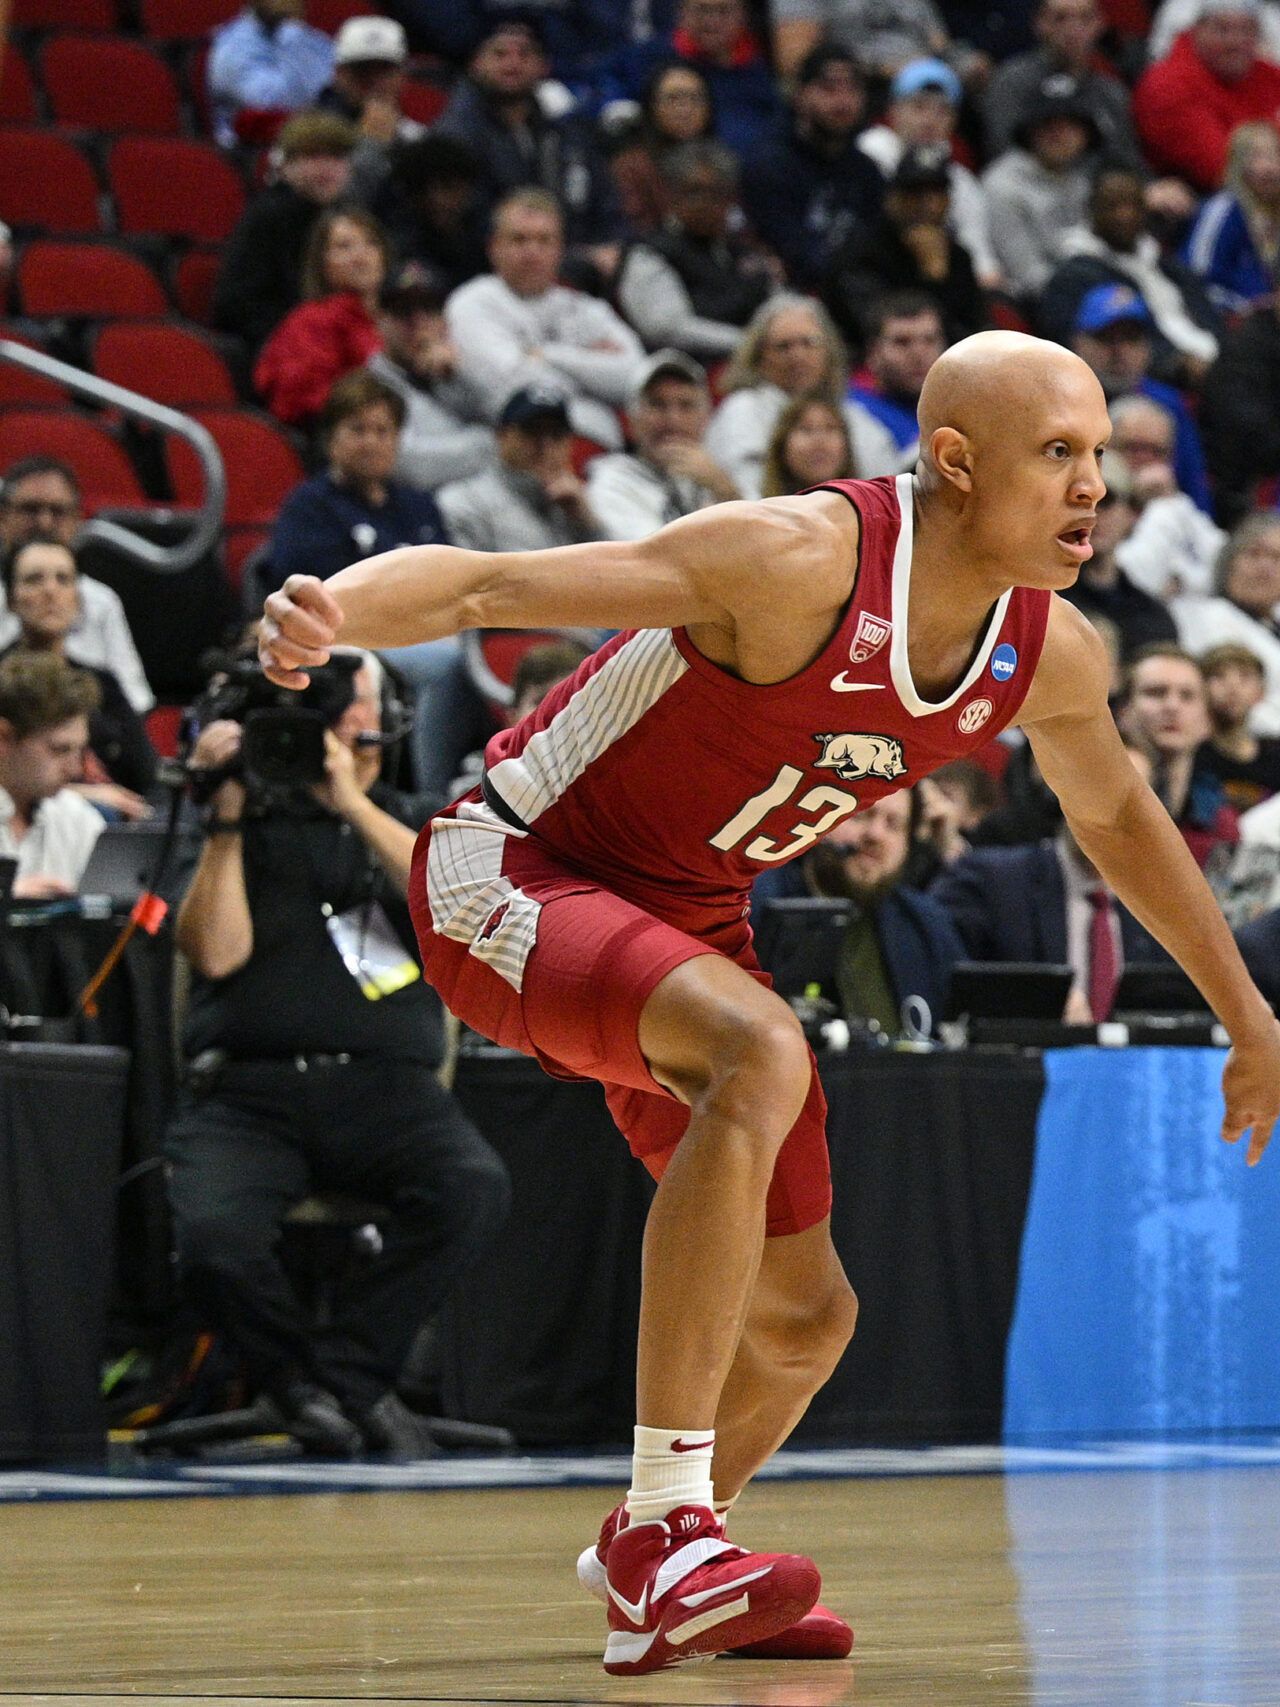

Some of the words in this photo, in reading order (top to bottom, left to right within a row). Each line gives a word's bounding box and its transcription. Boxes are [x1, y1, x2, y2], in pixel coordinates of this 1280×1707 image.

[860, 620, 887, 646] 100
[993, 660, 1015, 674] NCAA
[959, 700, 992, 733] SEC
[709, 763, 858, 861] 13
